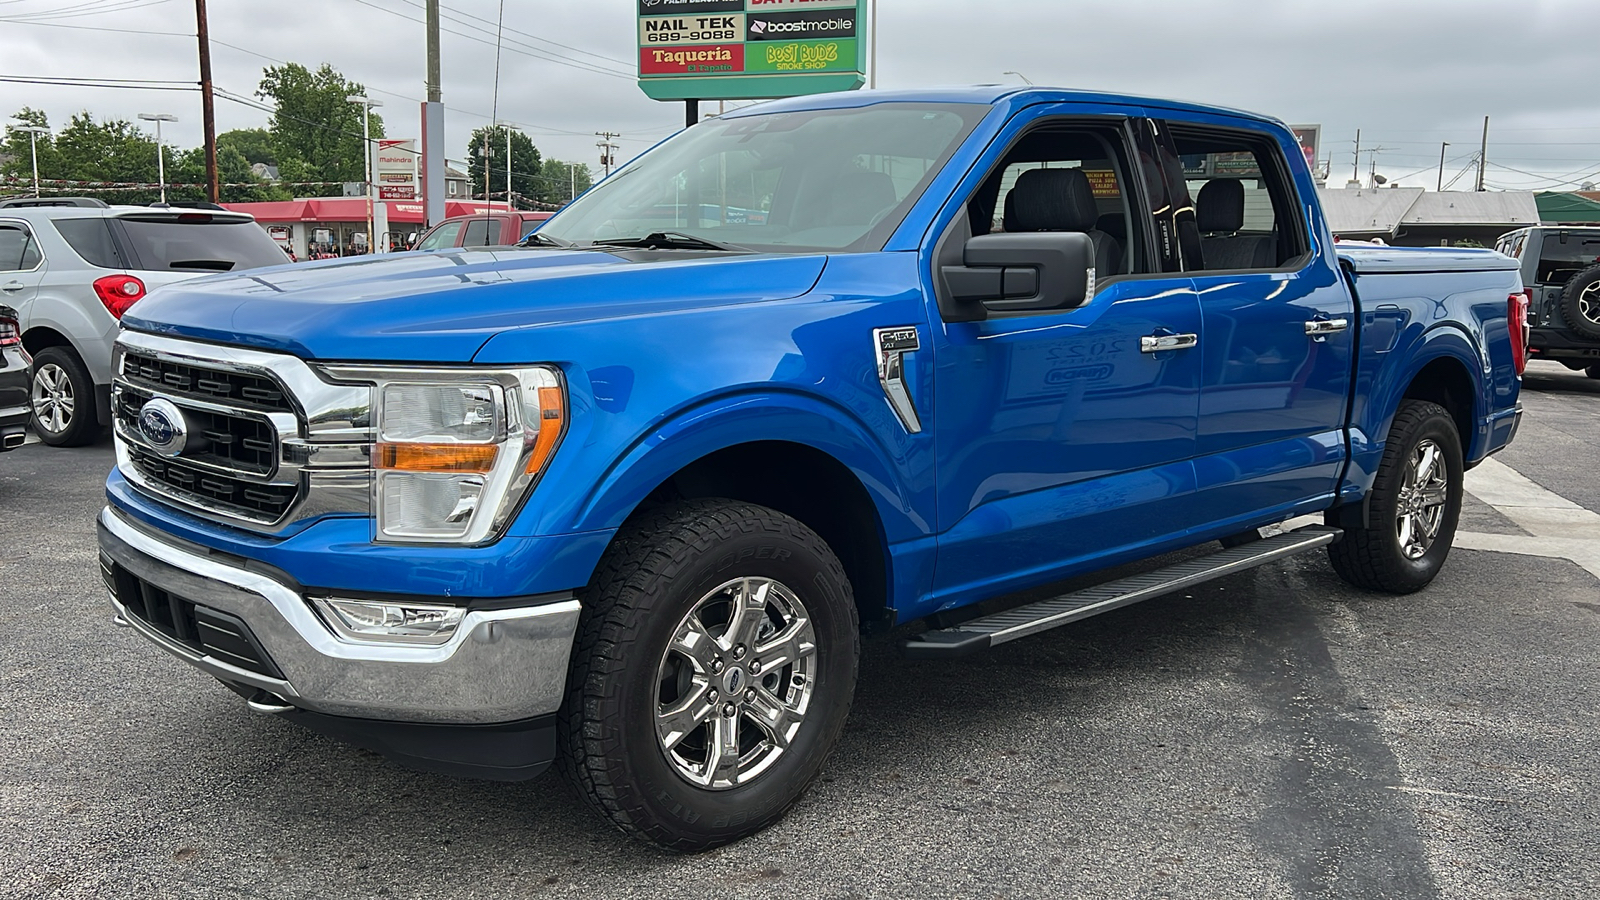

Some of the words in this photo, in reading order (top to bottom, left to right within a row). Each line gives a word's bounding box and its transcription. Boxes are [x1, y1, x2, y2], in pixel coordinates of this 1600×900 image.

[646, 19, 688, 31] NAIL
[696, 17, 735, 29] TEK
[767, 18, 853, 32] boostmobile
[647, 30, 735, 42] 689-9088
[776, 62, 803, 70] SMOKE
[804, 61, 827, 70] SHOP
